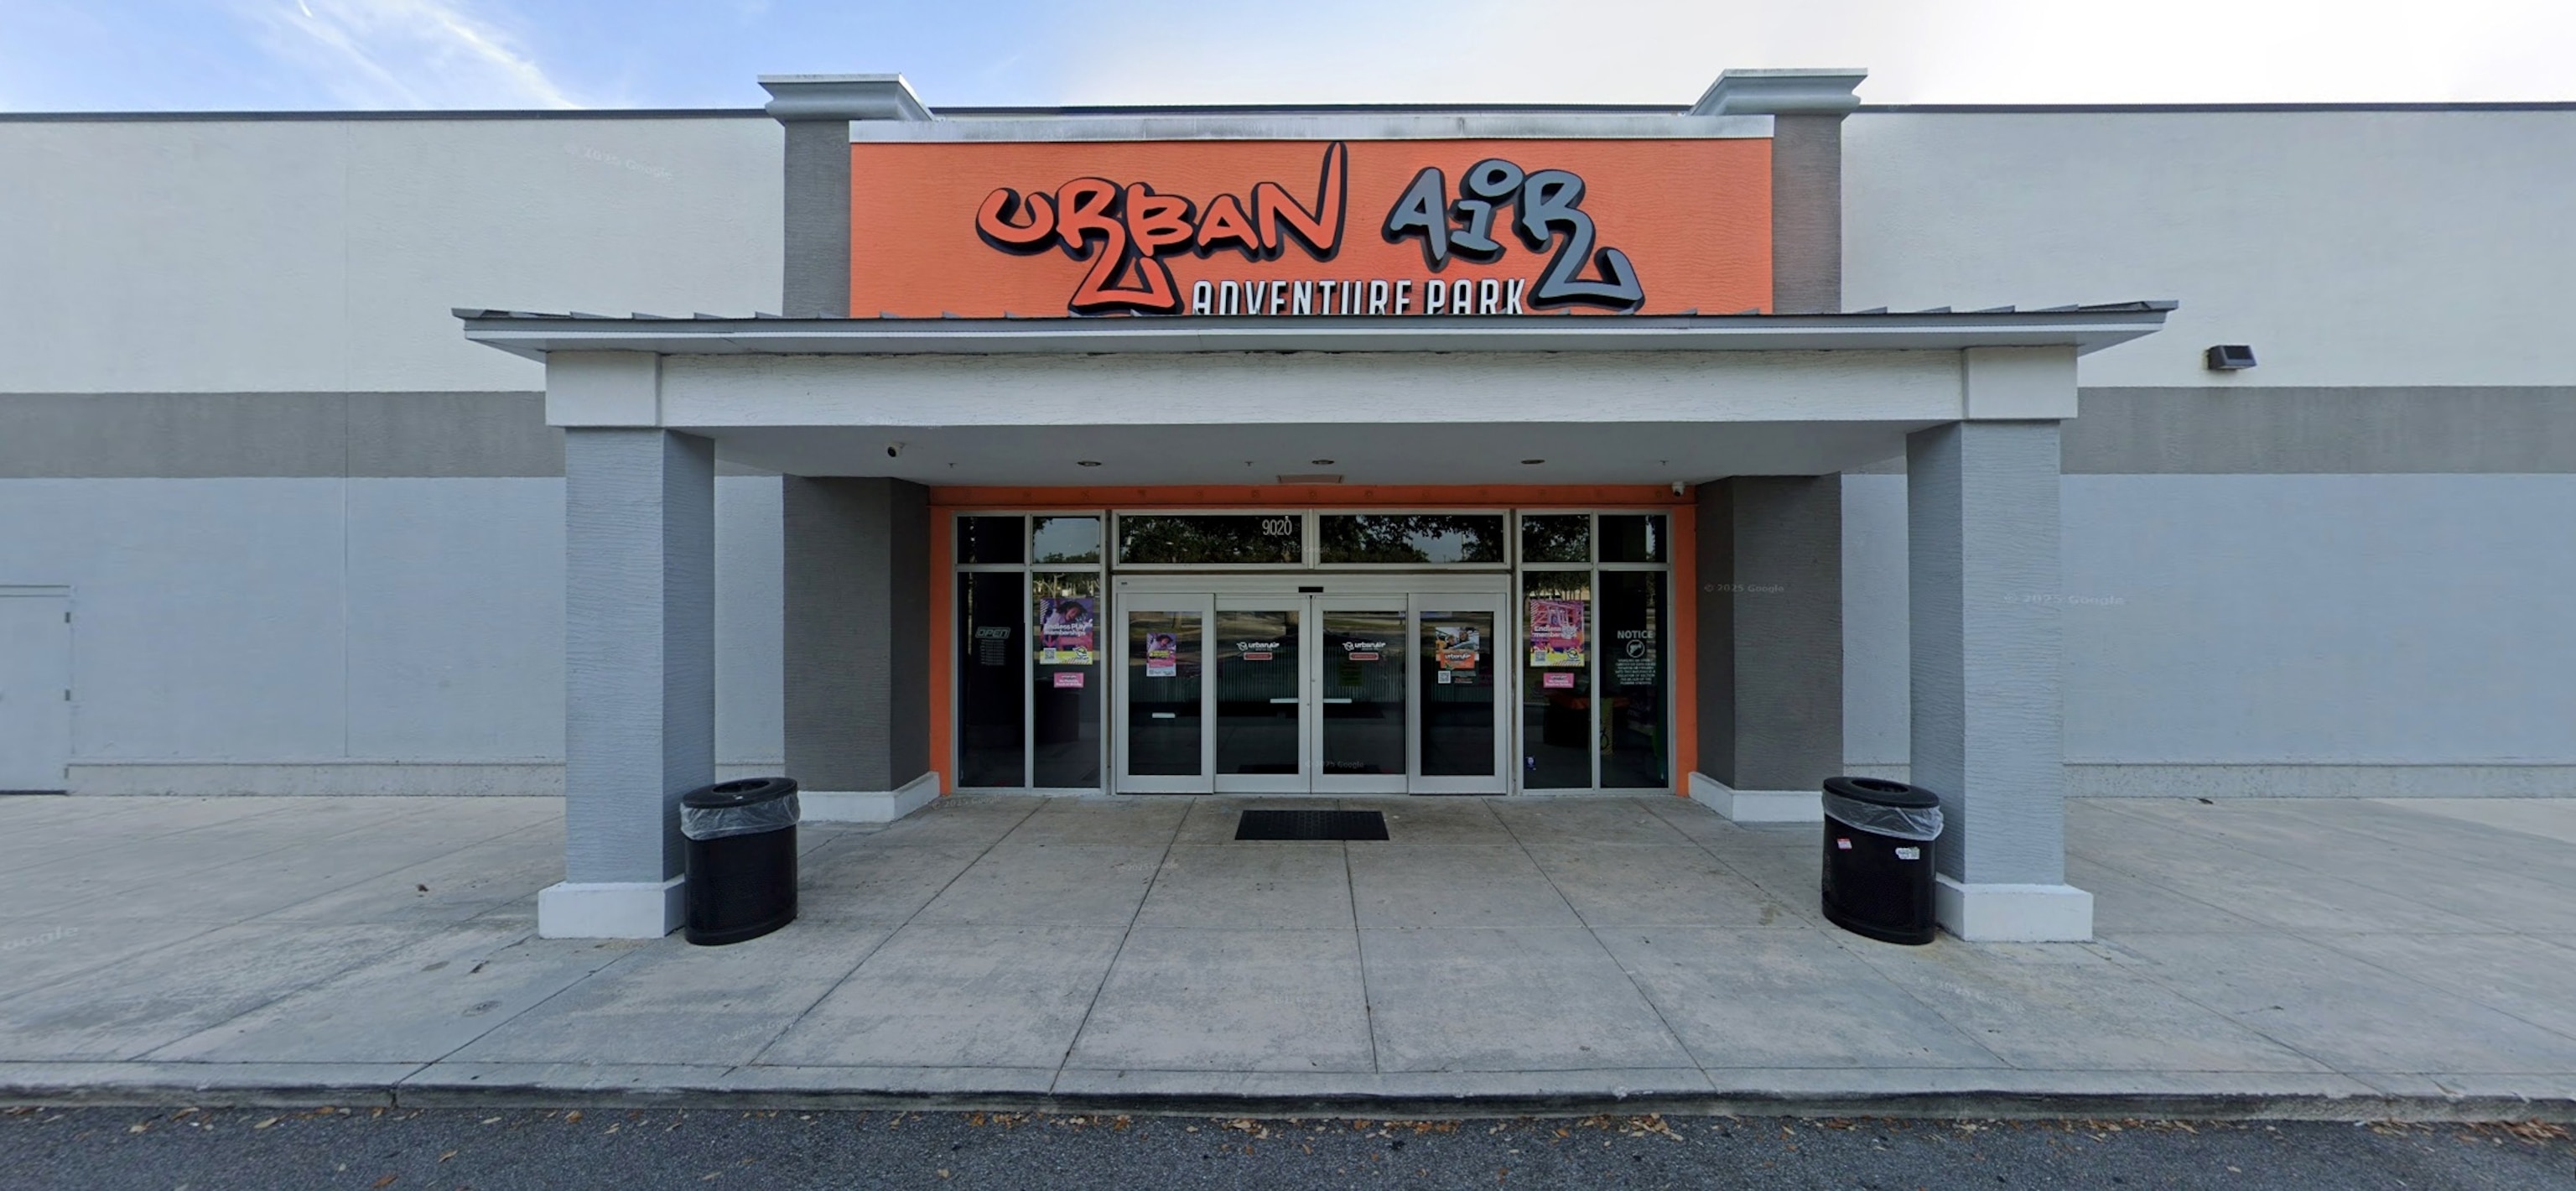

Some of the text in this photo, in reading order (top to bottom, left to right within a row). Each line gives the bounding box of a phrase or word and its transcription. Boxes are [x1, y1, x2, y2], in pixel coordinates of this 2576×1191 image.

[977, 140, 1348, 315] URBAN
[1192, 278, 1525, 315] ADVENTURE PARK
[1262, 519, 1292, 535] 9020
[977, 629, 1009, 637] OPEN
[1617, 630, 1654, 638] NOTICE
